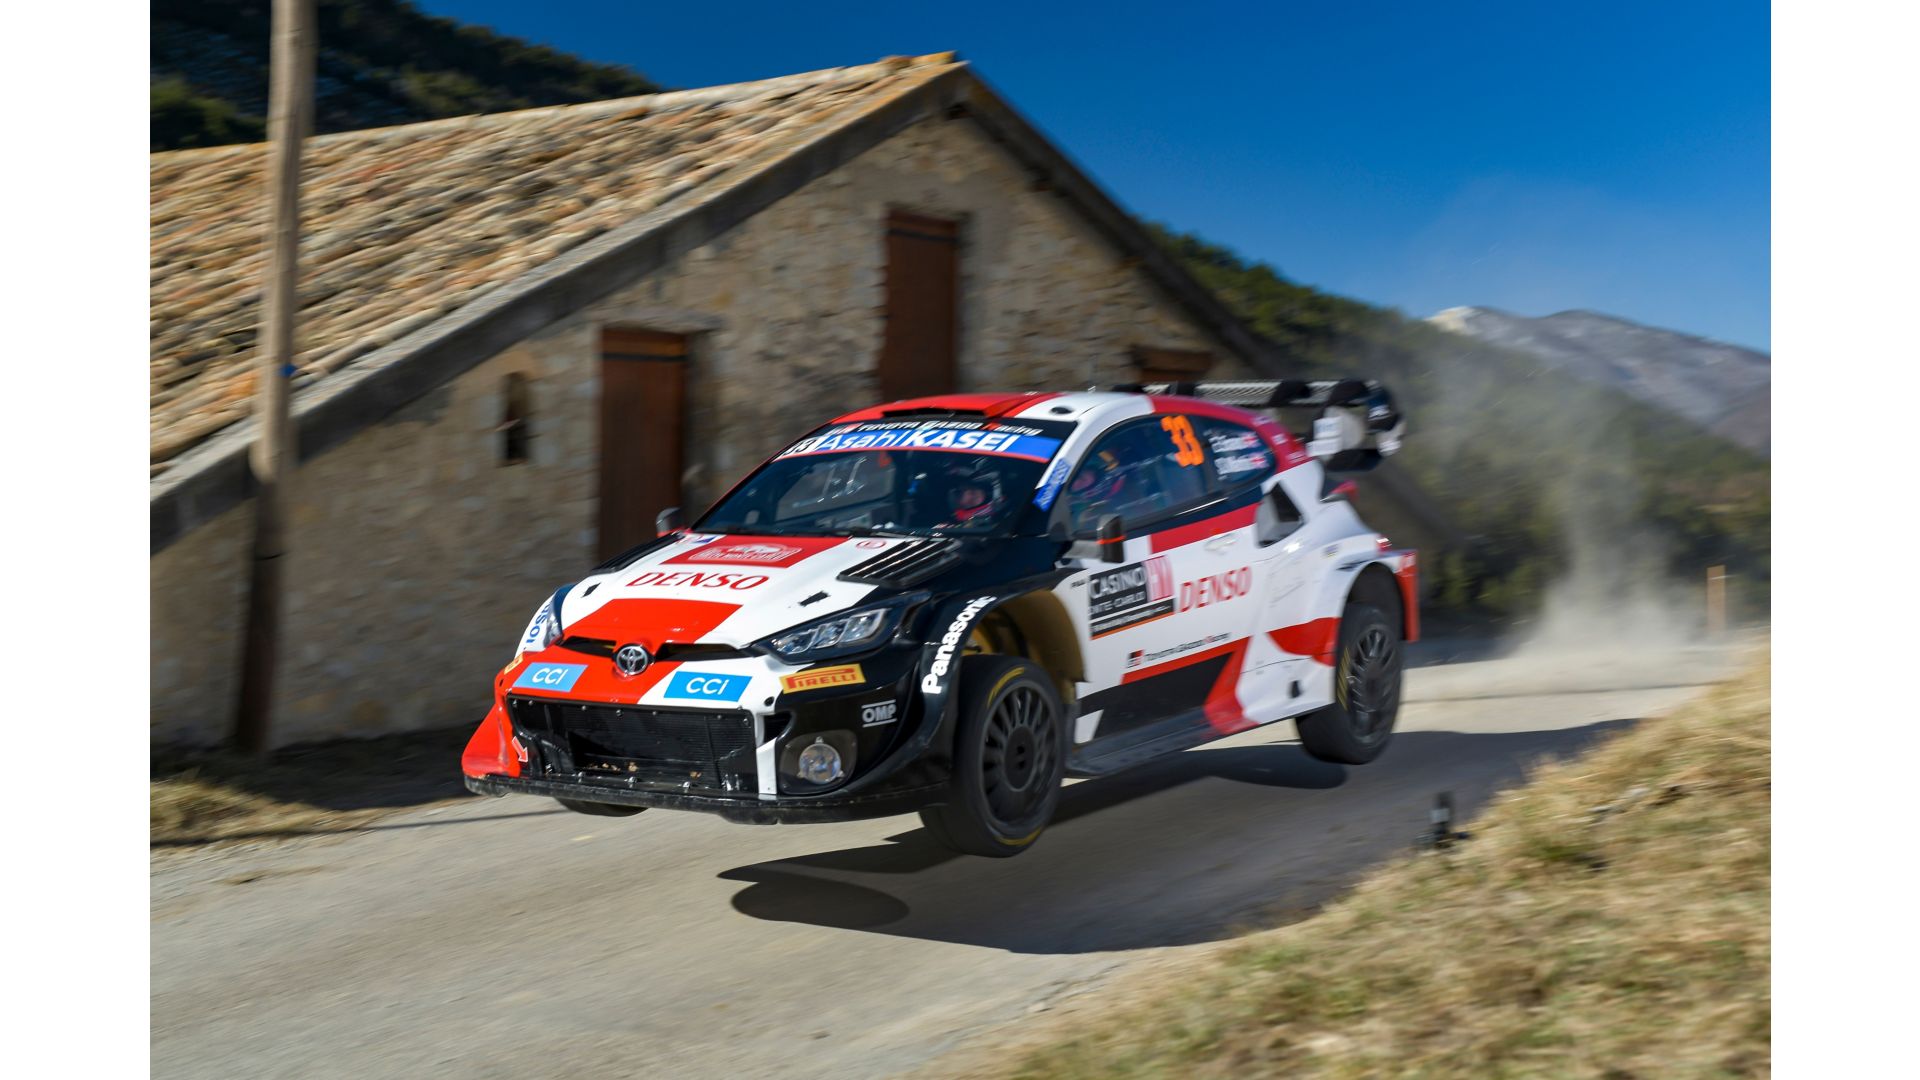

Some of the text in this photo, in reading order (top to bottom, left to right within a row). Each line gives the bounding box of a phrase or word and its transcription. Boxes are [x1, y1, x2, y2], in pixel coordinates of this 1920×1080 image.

[1160, 415, 1205, 467] 33
[625, 571, 770, 590] DENSO
[1179, 566, 1253, 613] DENSO
[921, 595, 997, 695] Panasonic
[531, 667, 568, 685] CCI
[685, 677, 729, 695] CCI
[786, 667, 857, 689] PIRELLI
[862, 704, 897, 723] OMP
